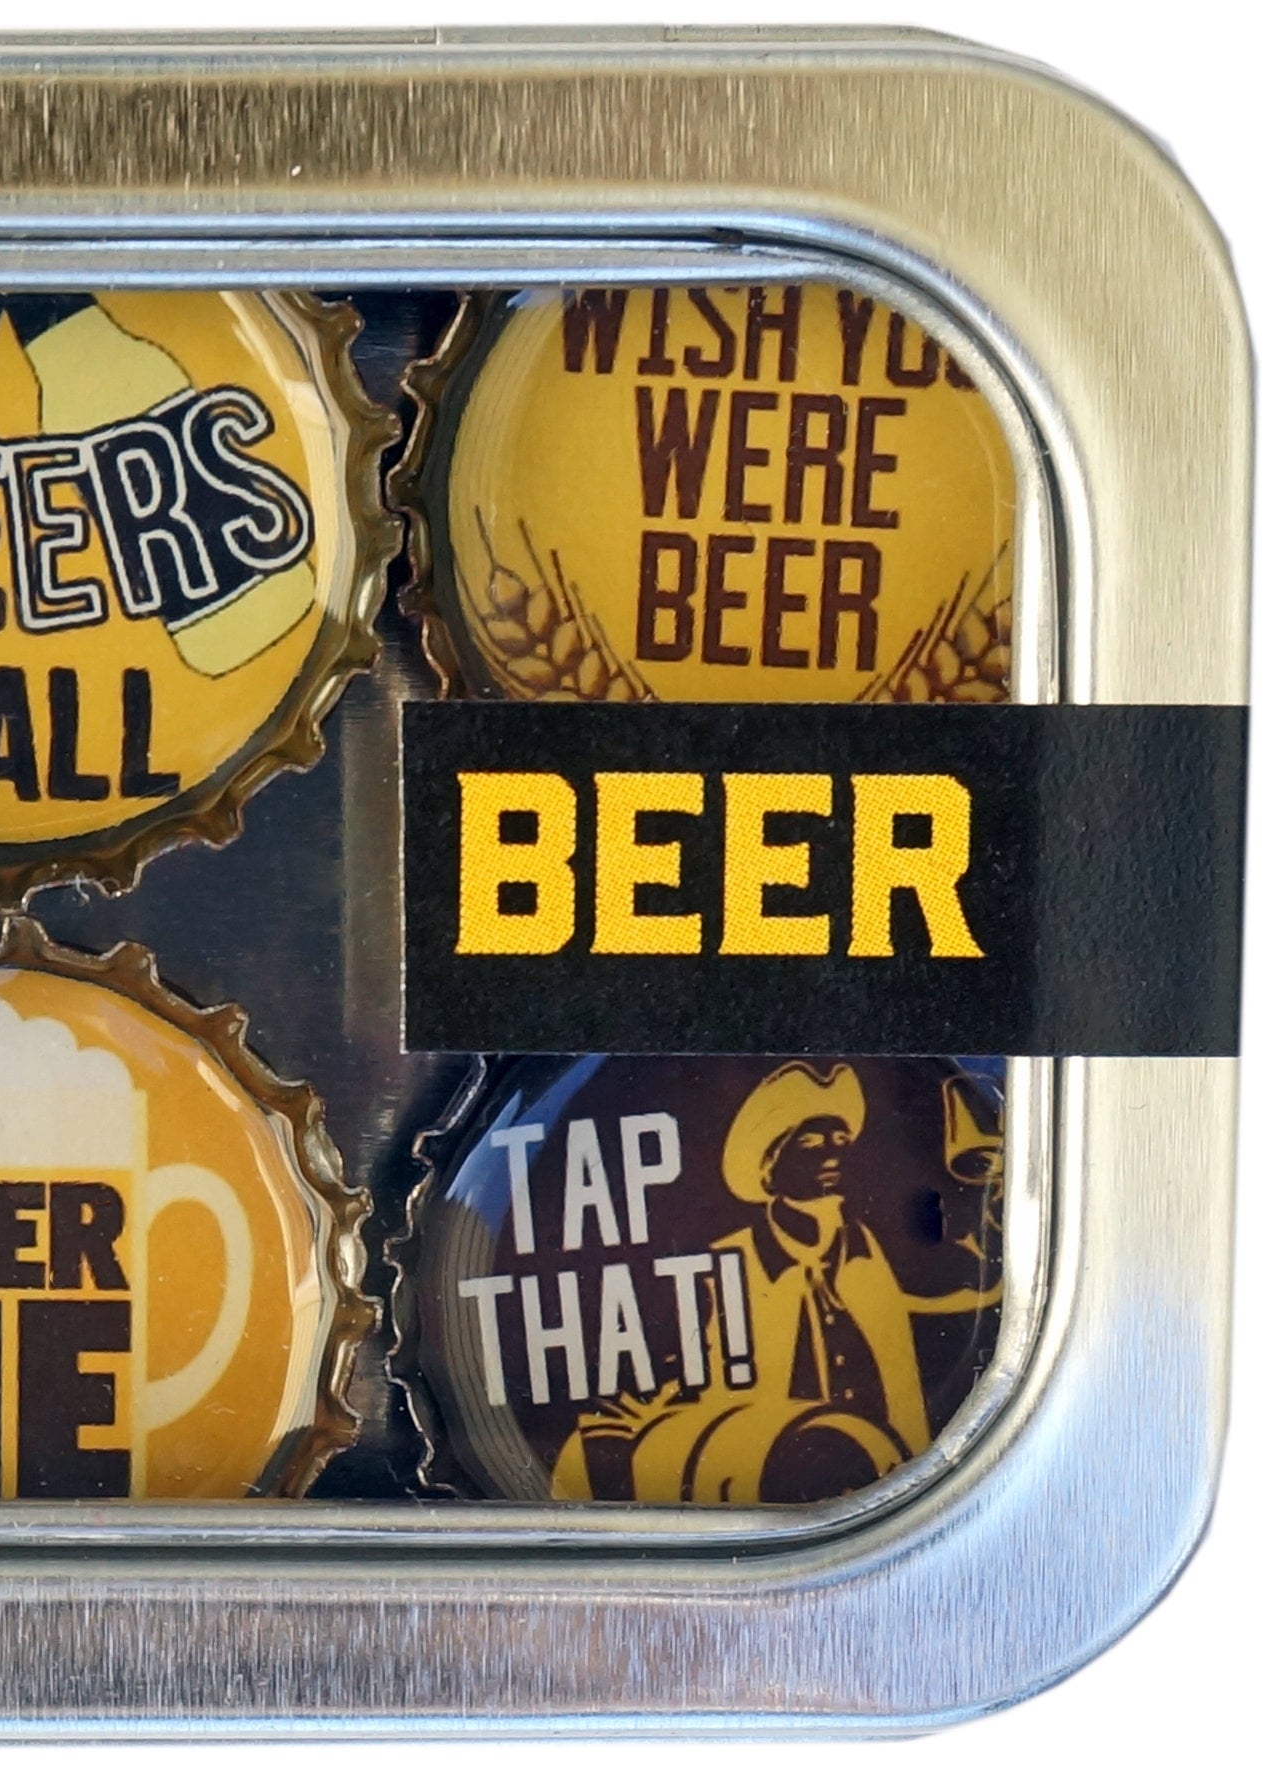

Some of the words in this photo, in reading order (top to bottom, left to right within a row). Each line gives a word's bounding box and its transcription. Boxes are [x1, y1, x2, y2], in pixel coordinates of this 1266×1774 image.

[561, 286, 803, 383] WISH
[836, 288, 980, 392] YO
[634, 385, 908, 531] WERE
[635, 530, 884, 673] BEER
[454, 770, 987, 960] BEER
[489, 1110, 683, 1255] TAP
[456, 1244, 758, 1408] THAT!
